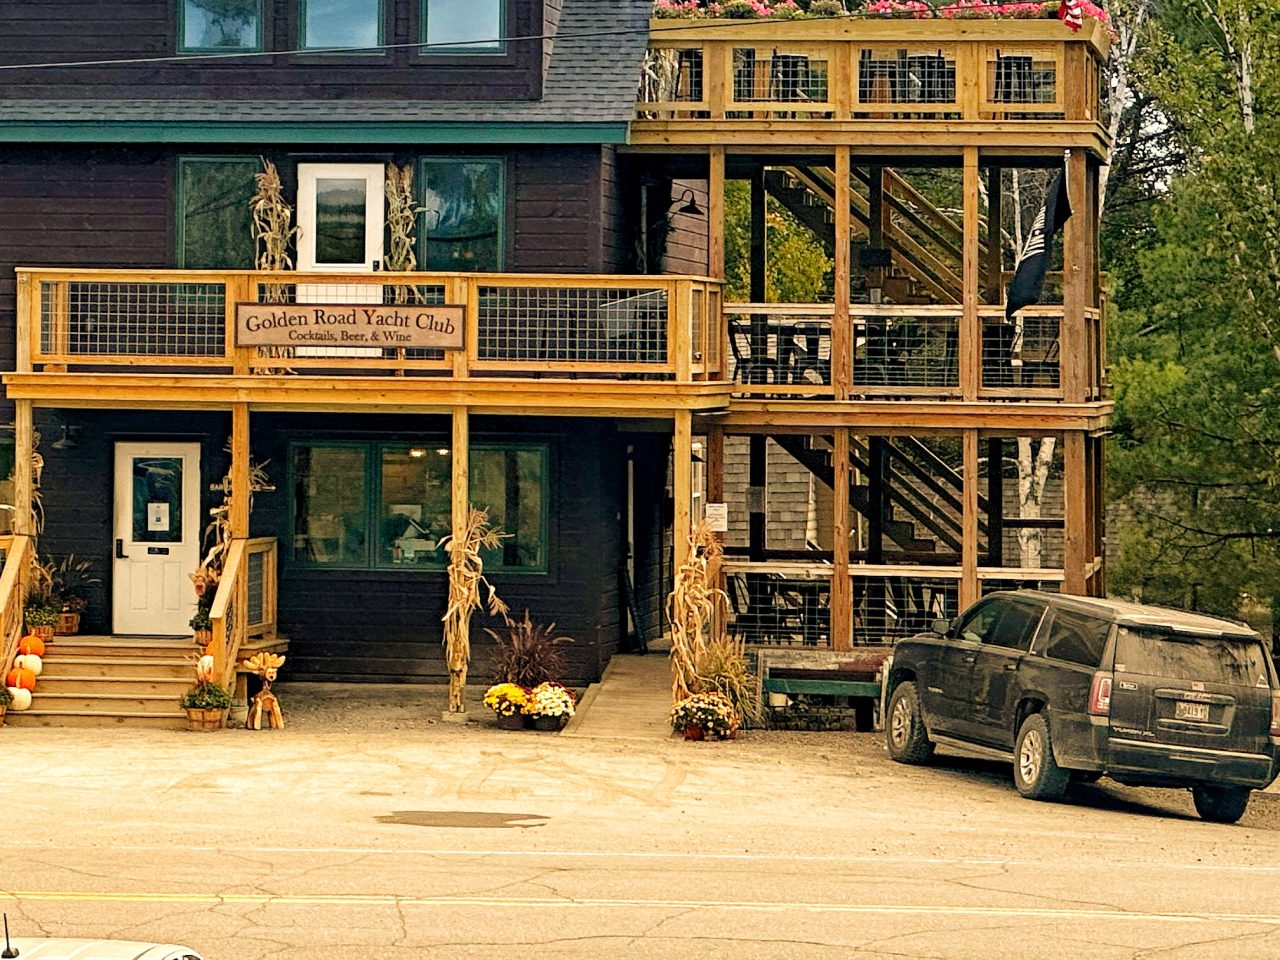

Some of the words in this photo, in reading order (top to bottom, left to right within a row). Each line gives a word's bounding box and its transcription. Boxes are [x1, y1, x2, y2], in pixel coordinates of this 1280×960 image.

[246, 312, 308, 332] Golden
[313, 309, 356, 325] Road
[362, 309, 411, 328] Yacht
[416, 313, 455, 335] Club
[288, 330, 338, 342] Cocktails,
[341, 331, 368, 343] Beer,
[370, 331, 379, 341] &
[383, 331, 412, 342] Wine
